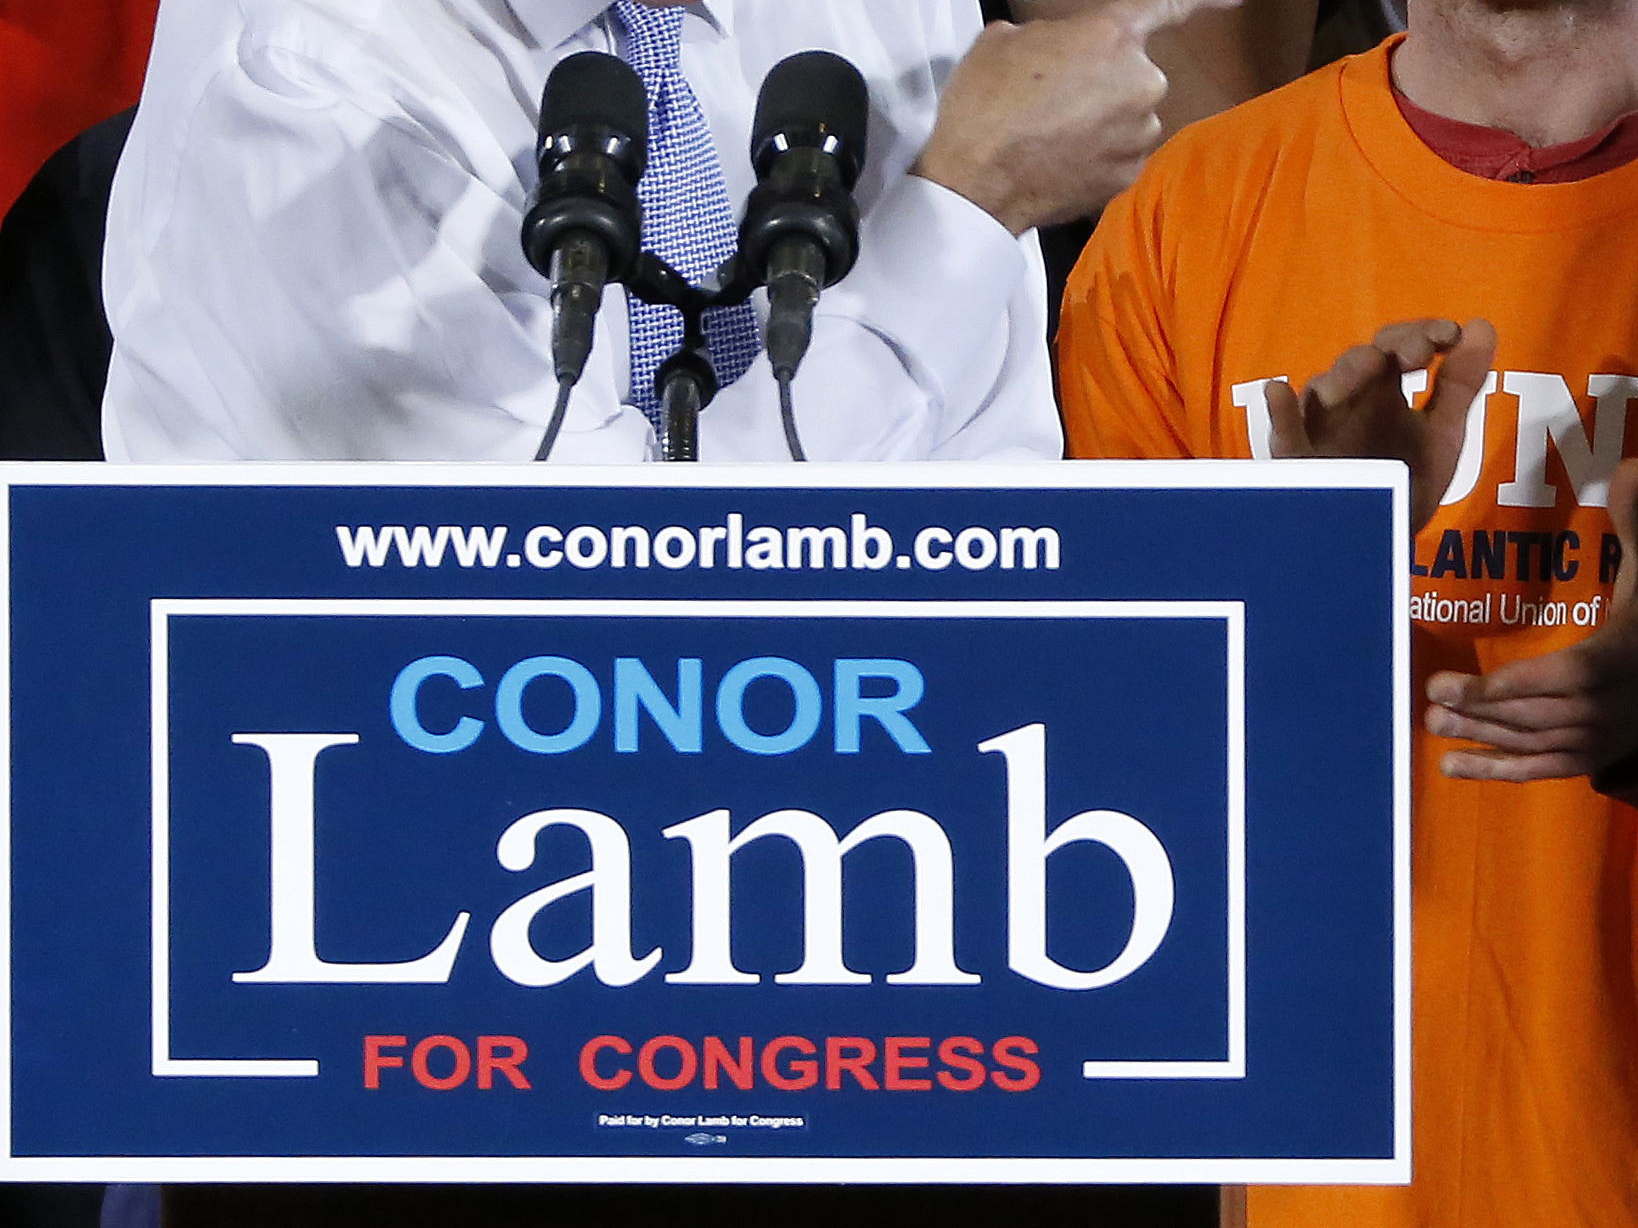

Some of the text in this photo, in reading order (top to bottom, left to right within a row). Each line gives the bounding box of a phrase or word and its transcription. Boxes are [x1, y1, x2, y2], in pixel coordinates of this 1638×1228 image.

[335, 513, 1060, 570] www.conorlamb.com
[1501, 593, 1567, 627] Union
[1572, 595, 1602, 627] of
[389, 655, 933, 755] CONOR
[232, 723, 1174, 990] Lamb
[363, 1034, 1041, 1092] FOR CONGRESS
[599, 1114, 804, 1130] Paid for by Conor Lamb for Congress
